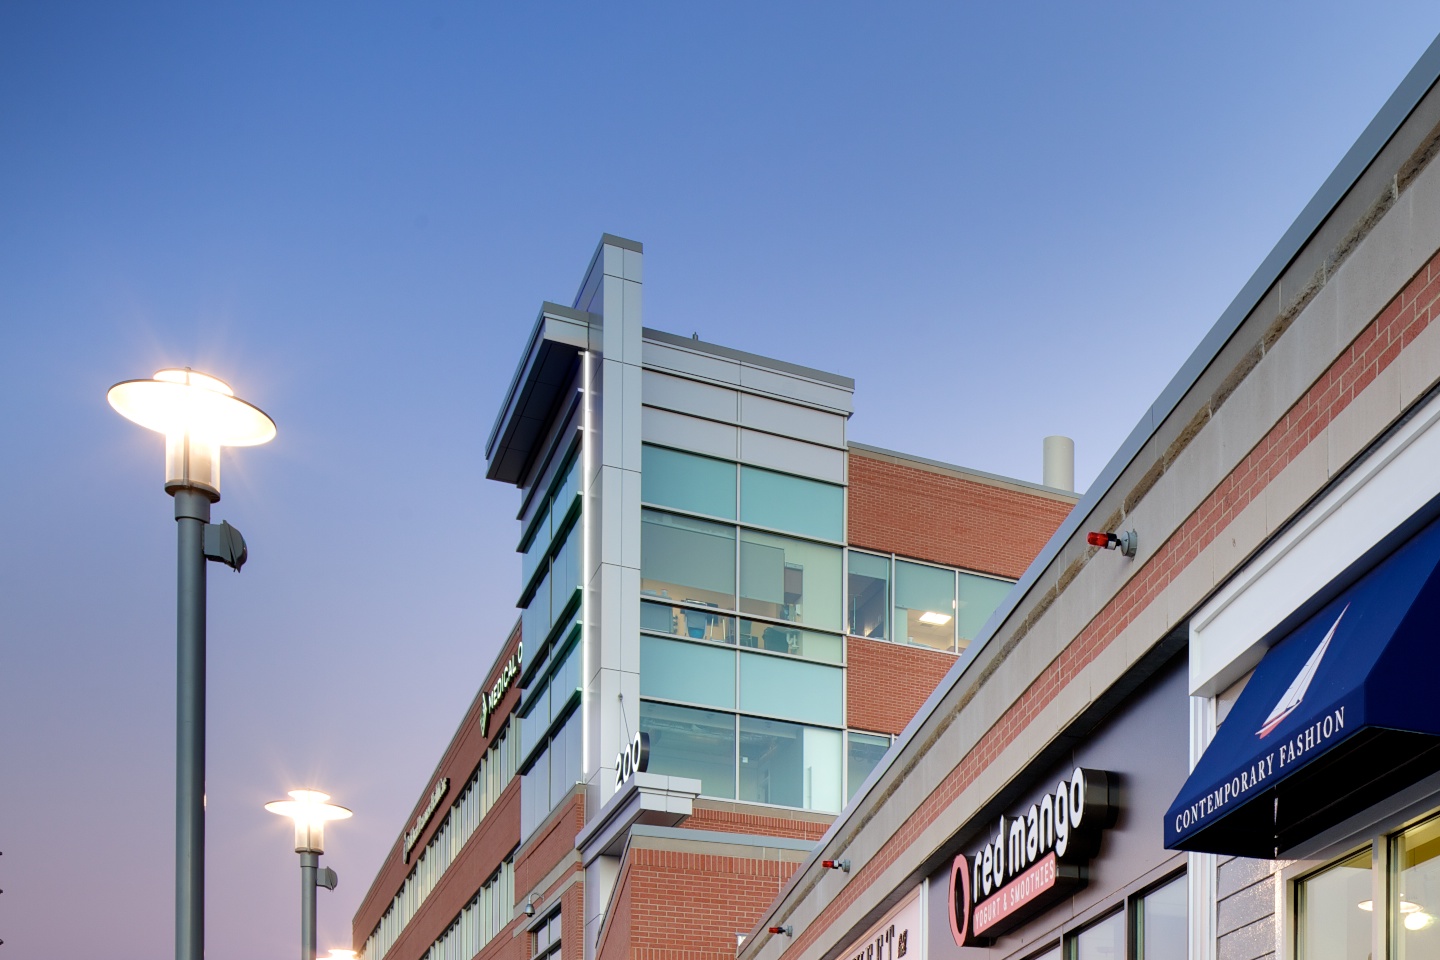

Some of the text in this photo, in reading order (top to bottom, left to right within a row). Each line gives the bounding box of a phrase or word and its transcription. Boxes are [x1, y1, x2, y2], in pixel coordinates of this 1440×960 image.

[488, 654, 519, 714] MEDICAL
[615, 731, 649, 794] 200
[1175, 705, 1346, 833] CONTEMPORARY FASHION
[973, 766, 1085, 904] red mango
[975, 859, 1055, 931] YOGURT & SMOOTHIES
